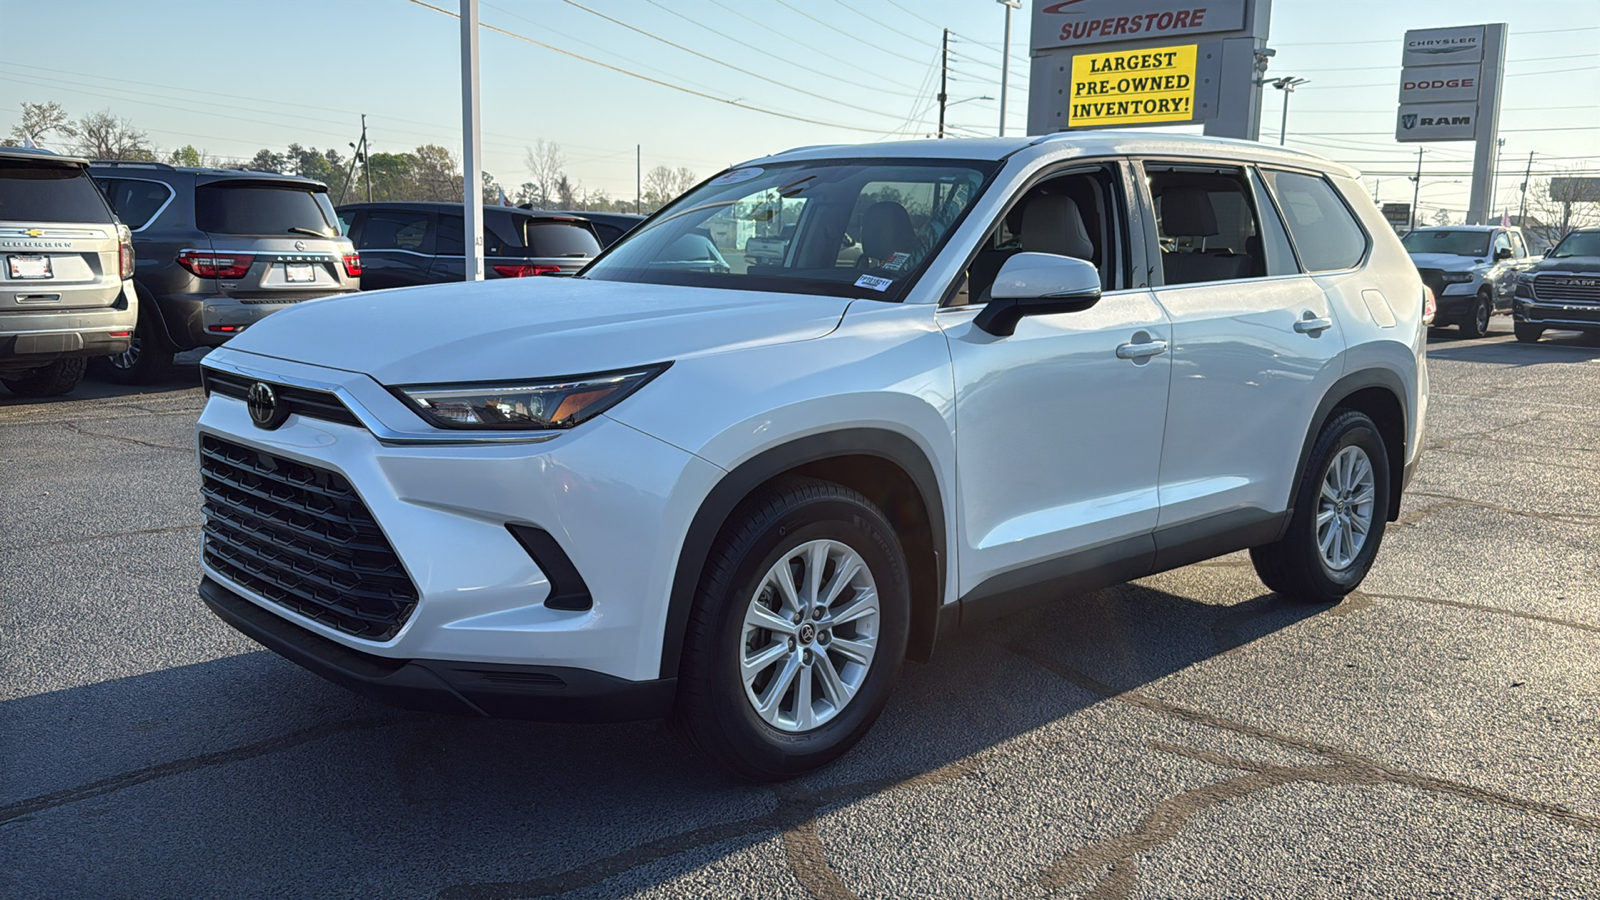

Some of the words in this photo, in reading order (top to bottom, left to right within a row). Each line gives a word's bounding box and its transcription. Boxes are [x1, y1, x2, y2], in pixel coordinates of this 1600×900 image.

[1059, 8, 1207, 40] SUPERSTORE
[1408, 38, 1476, 47] CHRYSLER
[1090, 52, 1177, 73] LARGEST
[1075, 74, 1190, 96] PRE-OWNED
[1403, 79, 1474, 90] DODGE
[1072, 97, 1190, 118] INVENTORY!
[1420, 116, 1471, 126] RAM
